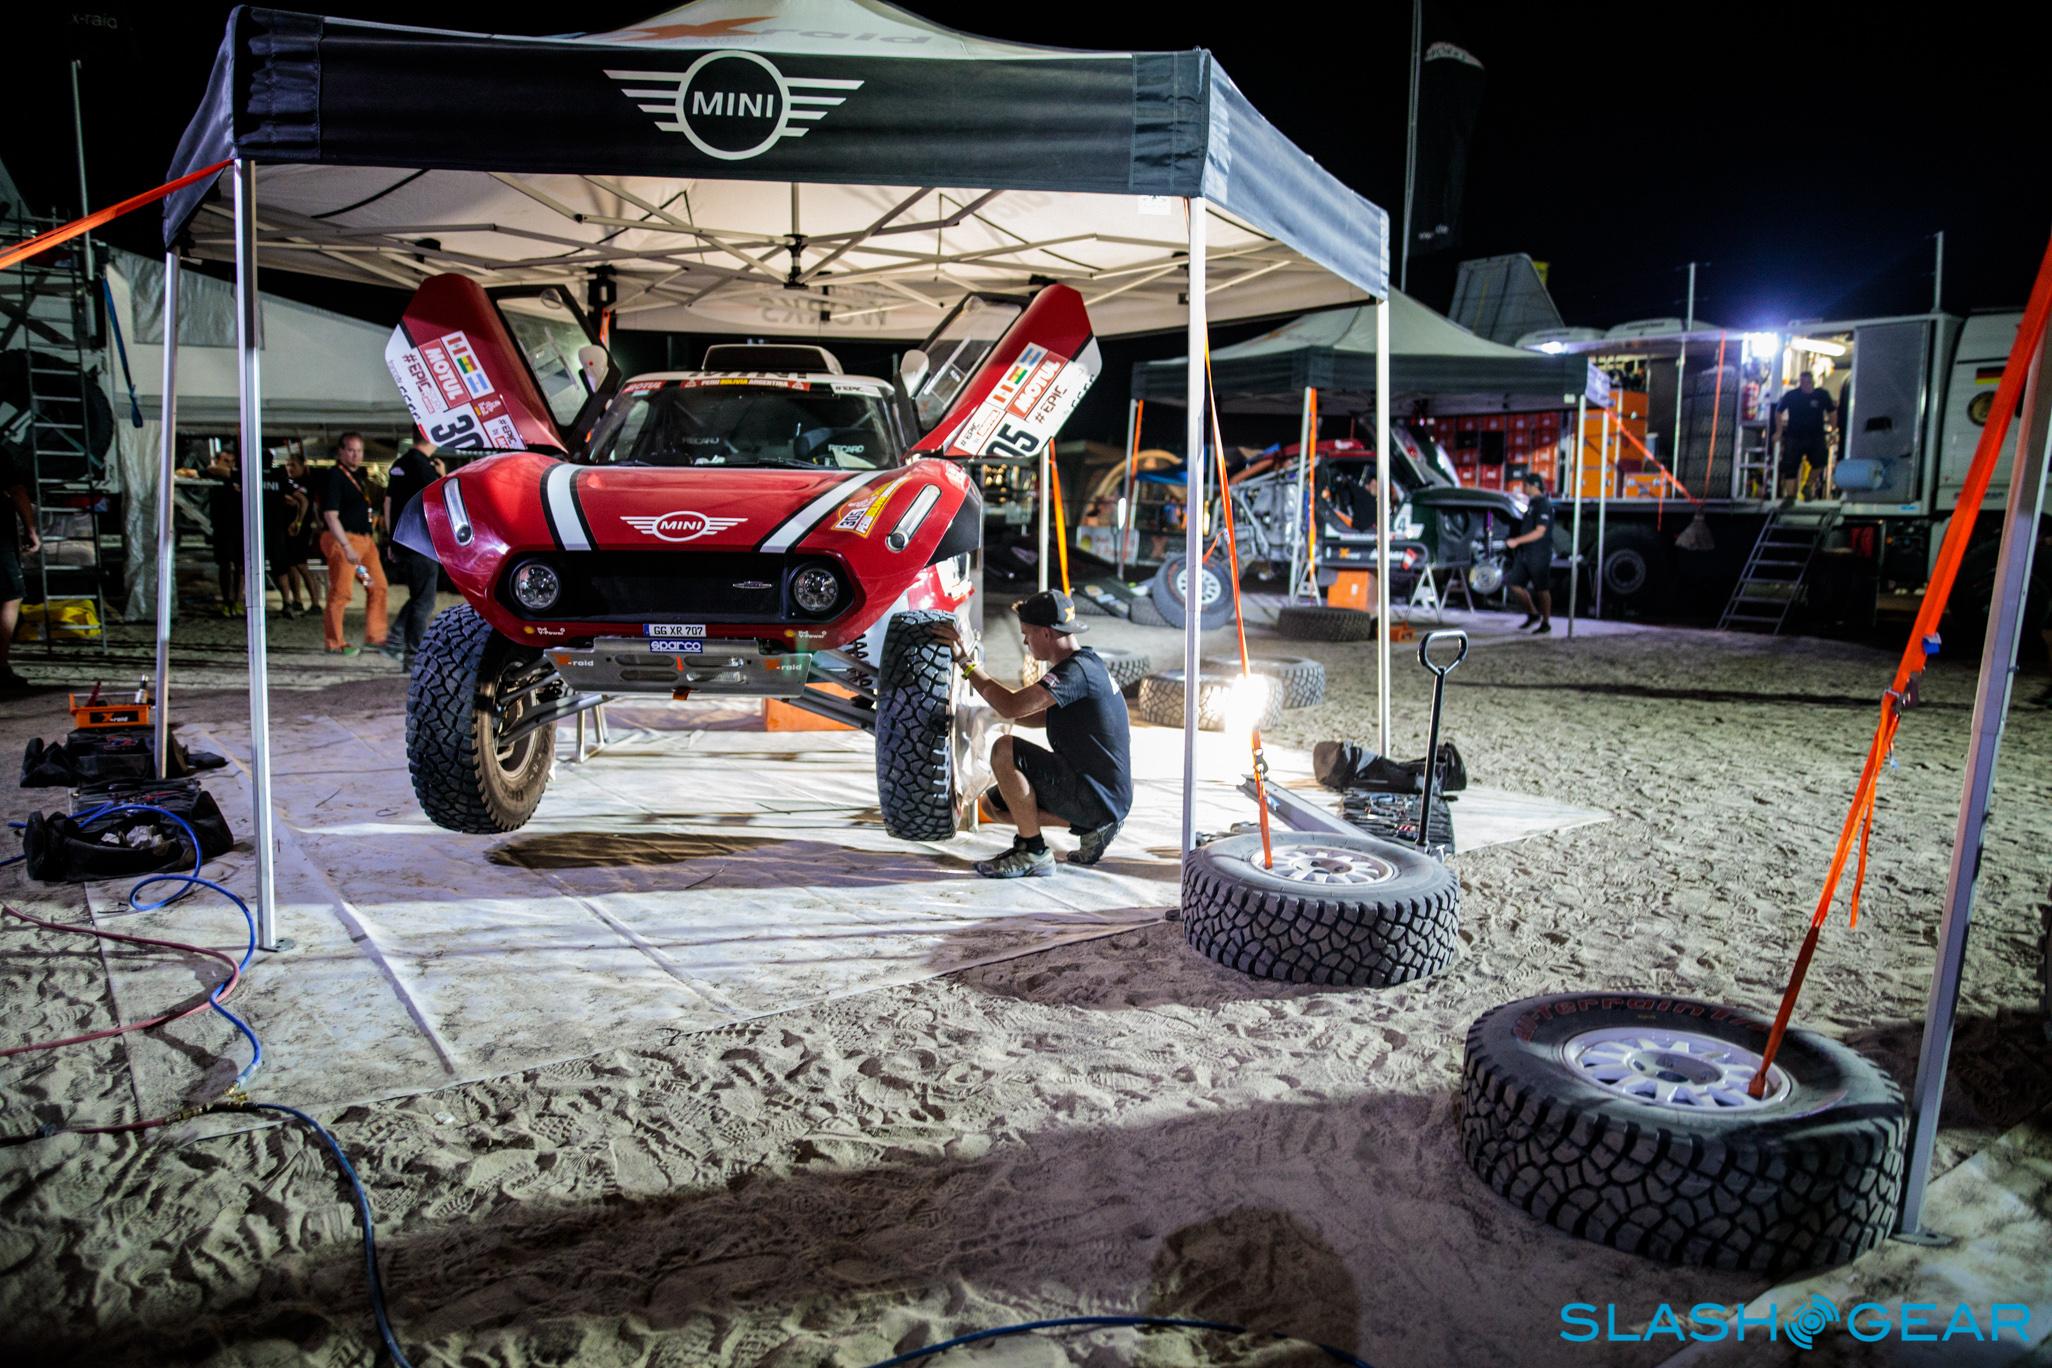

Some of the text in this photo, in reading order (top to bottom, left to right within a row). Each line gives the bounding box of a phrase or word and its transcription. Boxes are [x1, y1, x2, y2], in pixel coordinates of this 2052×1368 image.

[692, 91, 774, 118] MINI
[425, 347, 464, 401] MOTUL
[1013, 359, 1061, 413] MOTUL
[660, 521, 702, 530] MINI
[653, 626, 703, 636] GG XR 707
[651, 641, 701, 651] sparco
